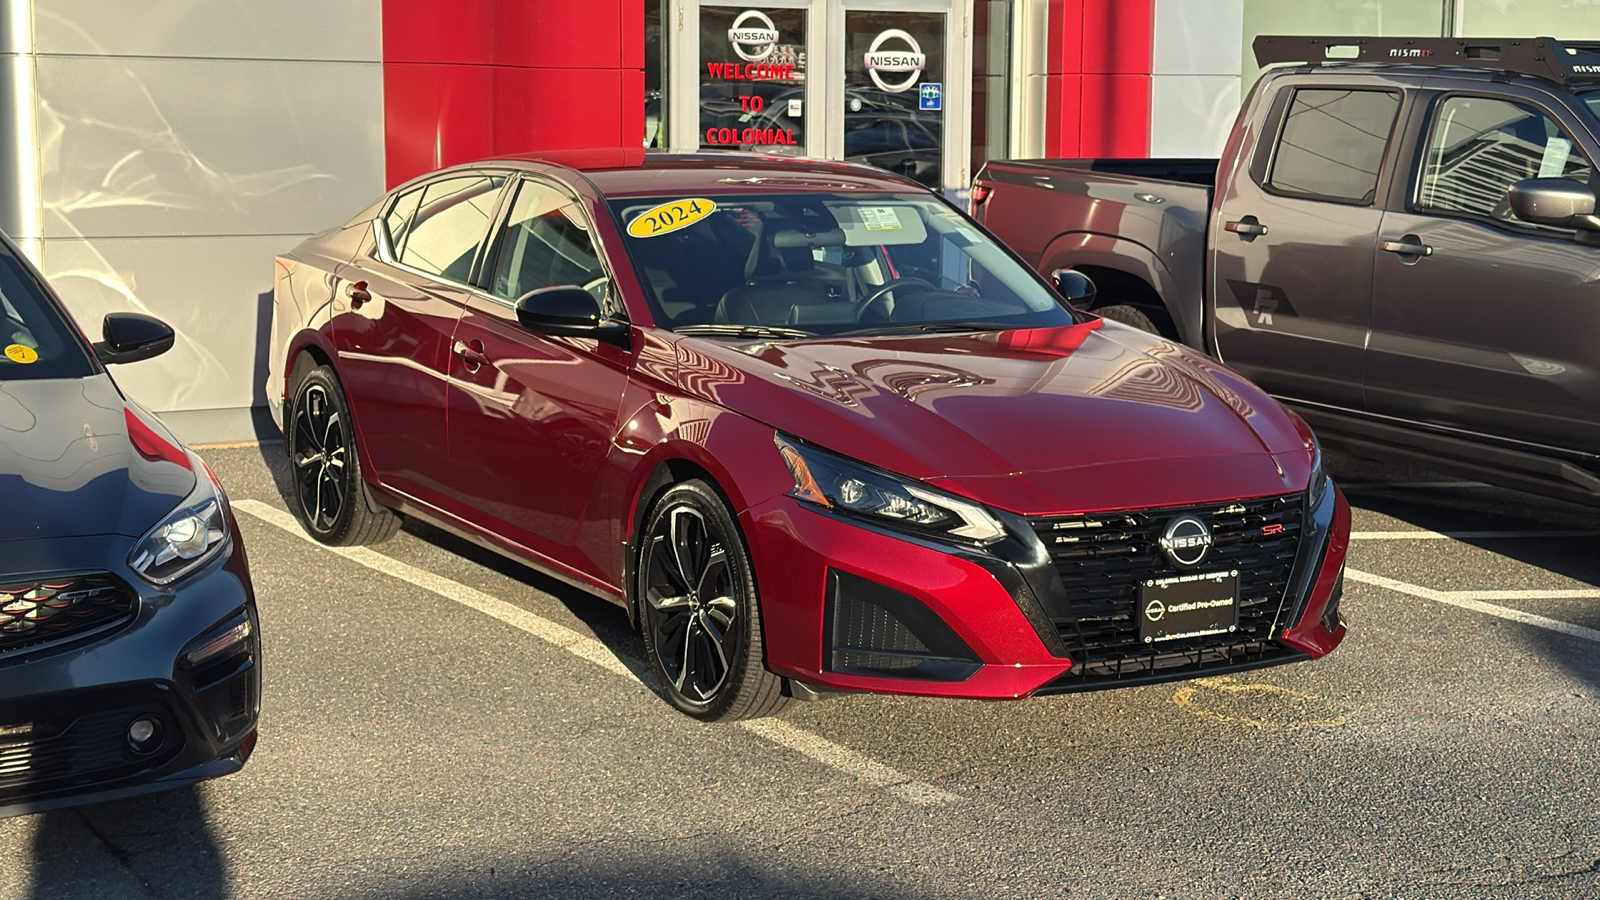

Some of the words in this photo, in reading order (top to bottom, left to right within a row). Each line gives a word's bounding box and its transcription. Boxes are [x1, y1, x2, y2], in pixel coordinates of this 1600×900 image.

[733, 32, 774, 41] NISSAN
[870, 56, 920, 67] NISSAN
[707, 62, 795, 80] WELCOME
[738, 95, 764, 113] TO
[706, 127, 797, 145] COLONIAL
[644, 199, 702, 233] 2024
[1262, 523, 1283, 536] SR
[1160, 534, 1212, 549] NISSAN
[1167, 601, 1197, 613] Certified
[1196, 596, 1234, 609] Pre-Owned
